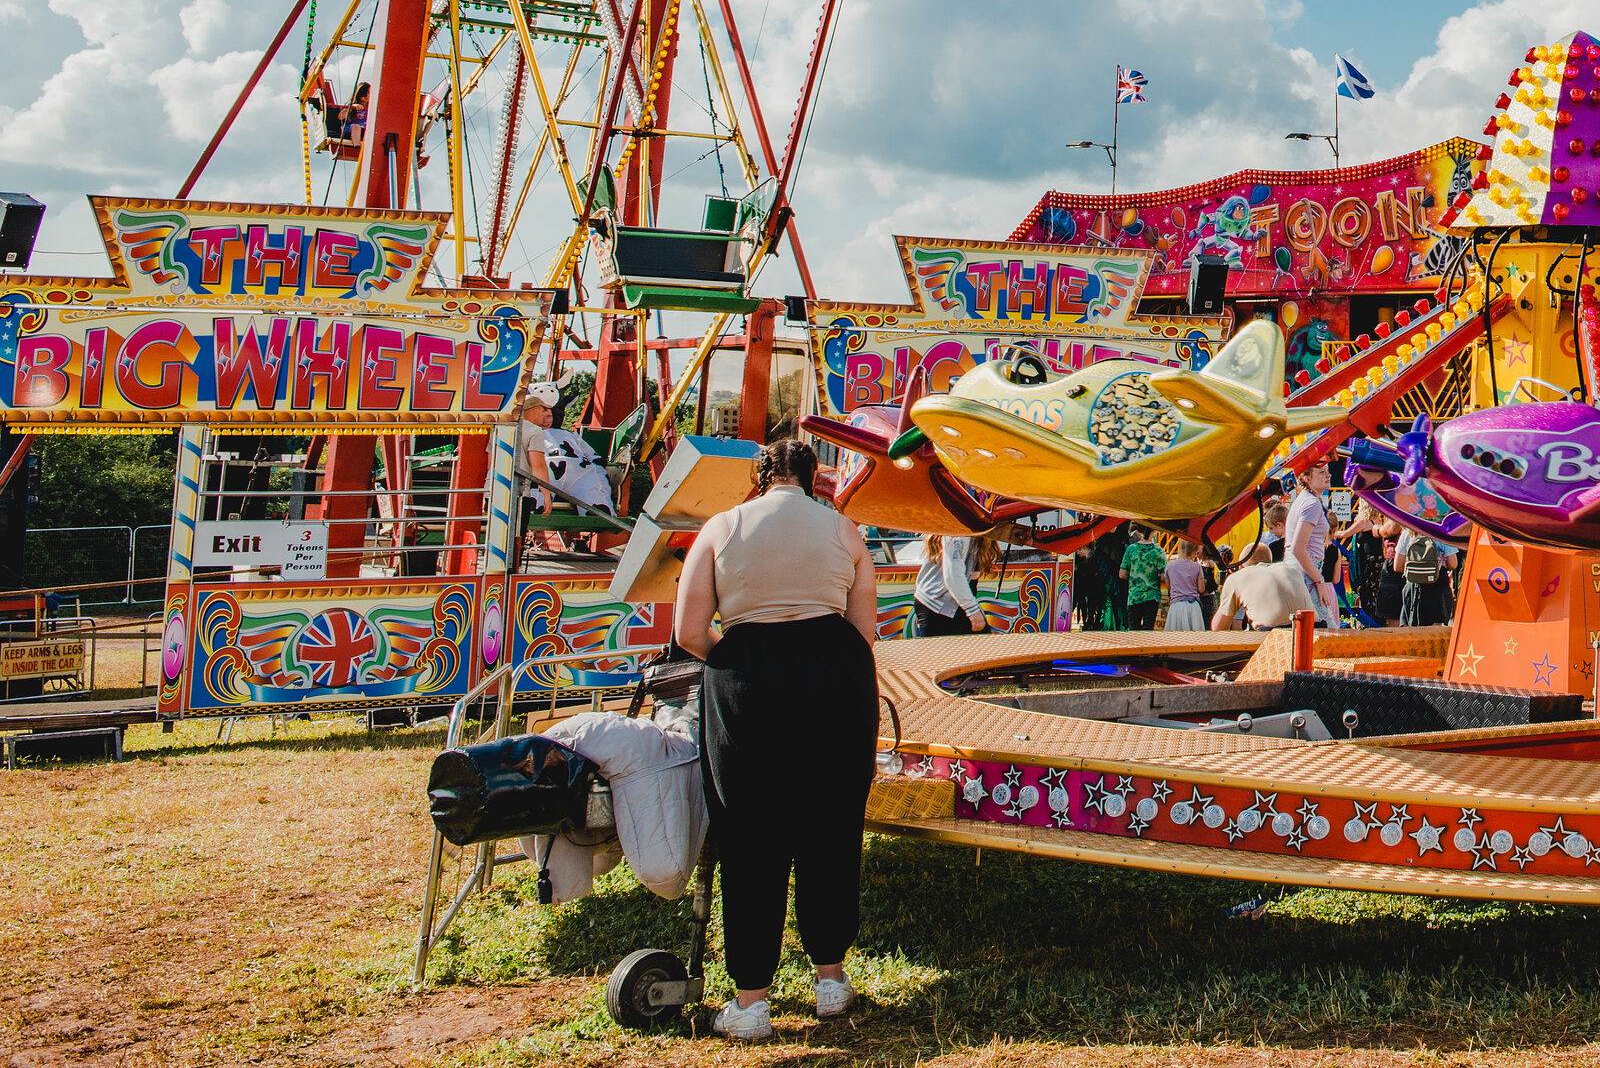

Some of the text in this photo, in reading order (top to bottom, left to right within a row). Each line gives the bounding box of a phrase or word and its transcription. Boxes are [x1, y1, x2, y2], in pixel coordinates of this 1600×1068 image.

[1250, 186, 1430, 259] TOON
[187, 223, 360, 290] THE
[965, 259, 1091, 315] THE
[11, 316, 505, 411] BIG WHEEL
[844, 339, 966, 414] BIG
[212, 535, 262, 553] Exit
[300, 530, 312, 542] 3
[287, 544, 323, 552] Tokens
[295, 553, 314, 561] Per
[285, 563, 323, 571] Person
[4, 644, 83, 660] KEEP ARMS & LEGS
[12, 658, 75, 673] INSIDE THE CAR
